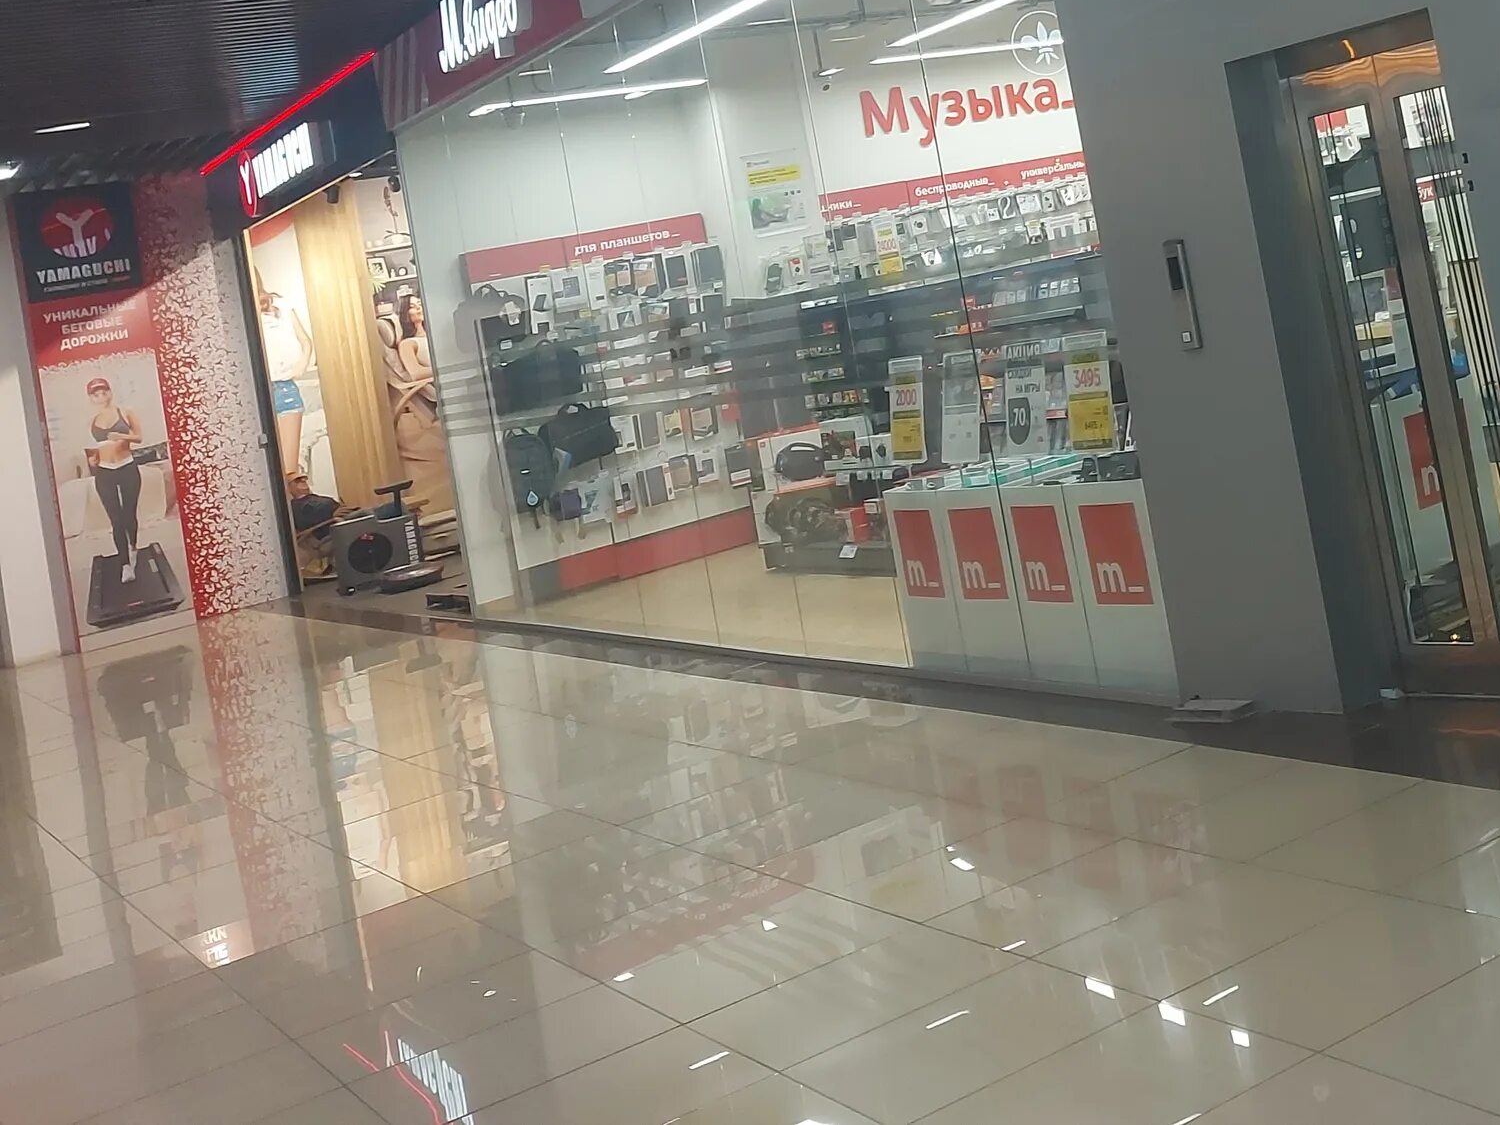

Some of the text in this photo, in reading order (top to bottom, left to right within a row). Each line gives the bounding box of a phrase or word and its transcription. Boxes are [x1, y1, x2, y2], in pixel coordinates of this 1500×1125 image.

[36, 258, 131, 285] YAMAGUCHI
[43, 299, 137, 324] УНИКАЛЬНЫЕ
[61, 315, 125, 335] БЕГОВЫЕ
[60, 328, 129, 351] ДОРОЖКИ
